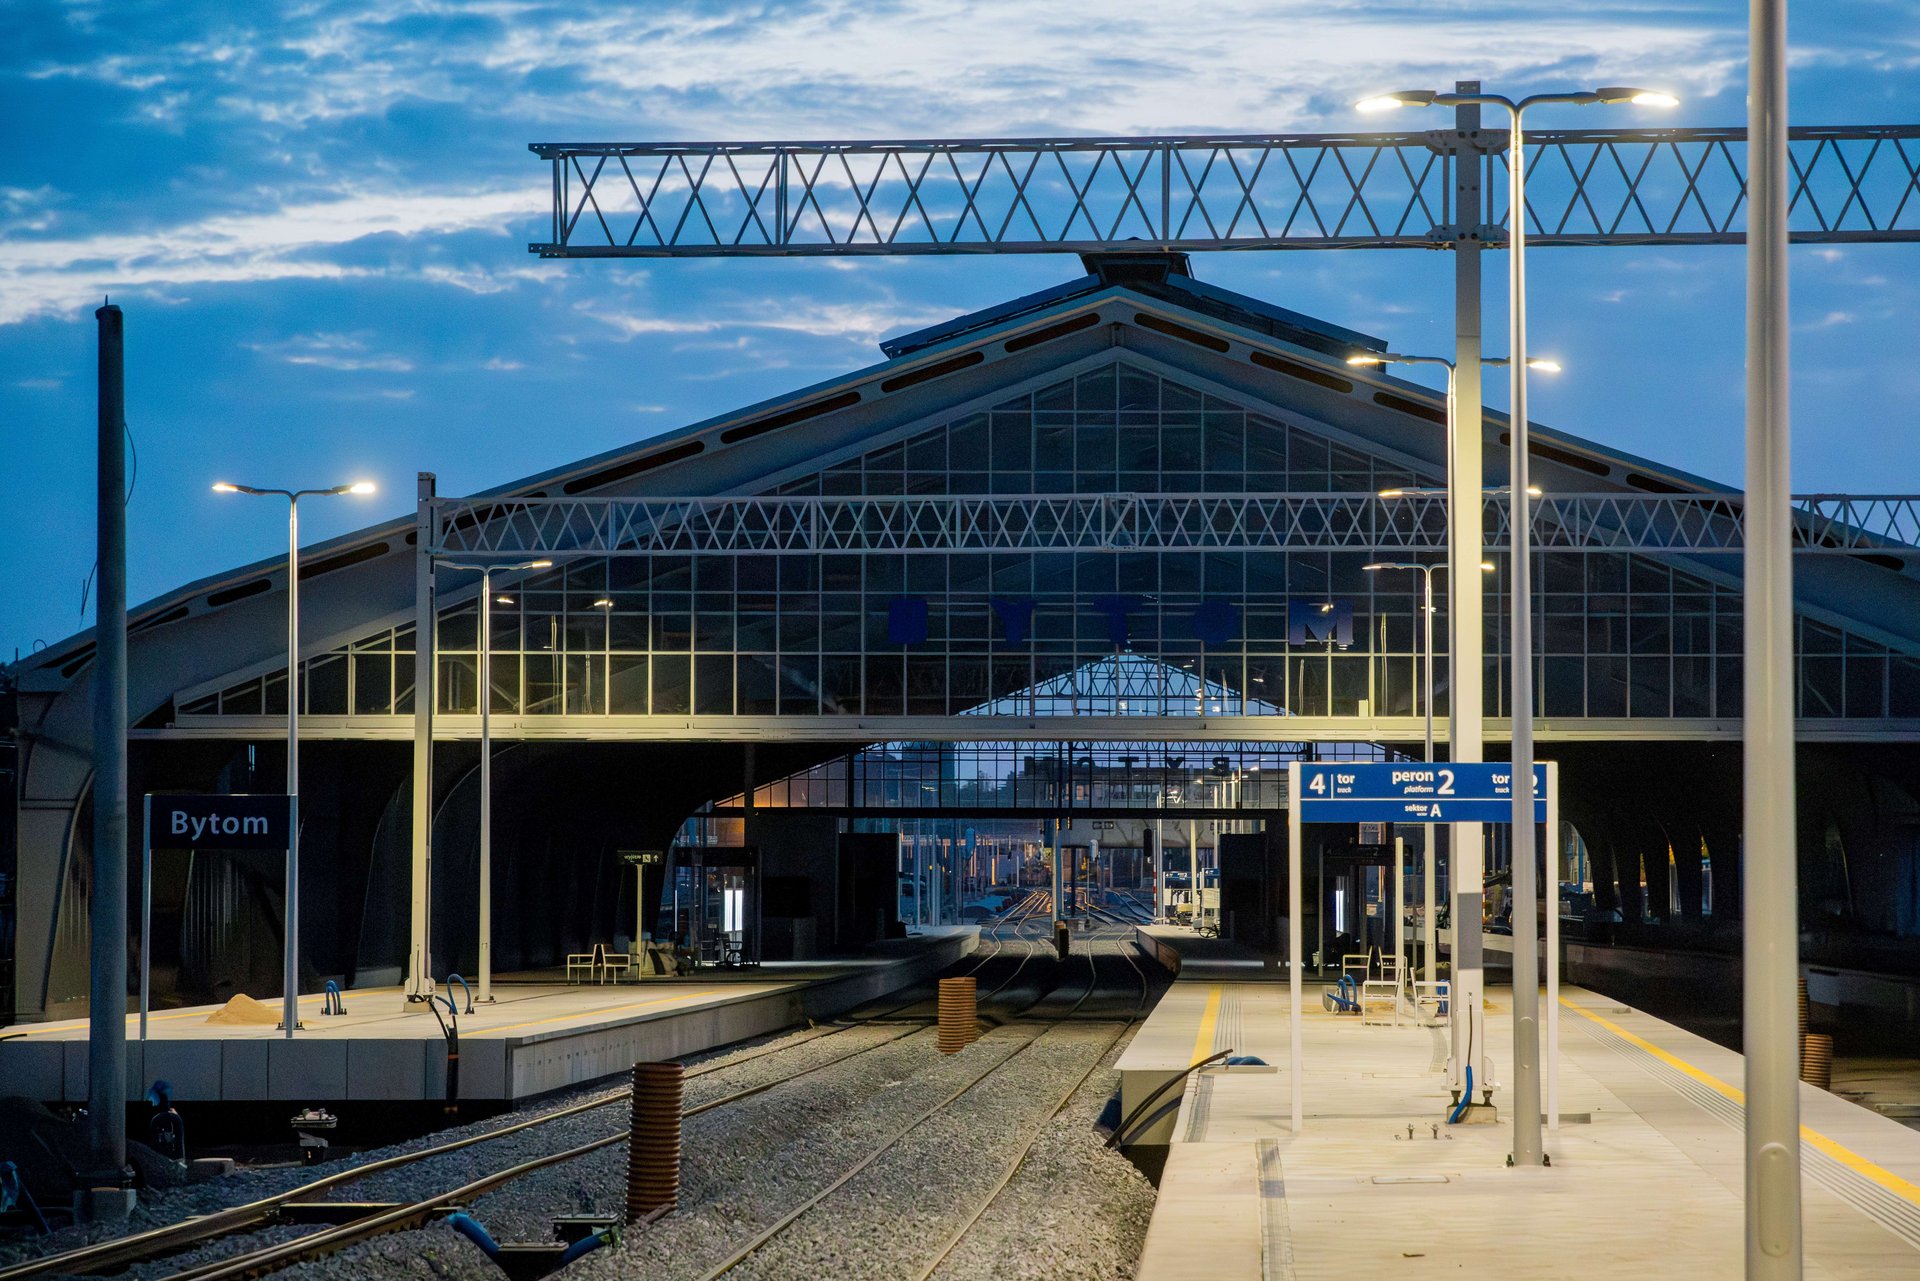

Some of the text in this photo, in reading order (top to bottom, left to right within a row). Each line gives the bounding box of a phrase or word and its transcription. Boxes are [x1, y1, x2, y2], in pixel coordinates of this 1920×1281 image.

[1309, 773, 1326, 795] 4
[1337, 773, 1355, 784] tor
[1391, 769, 1455, 795] peron 2
[1491, 773, 1510, 784] tor
[1403, 785, 1434, 795] platform
[1404, 803, 1428, 812] sektor
[1430, 803, 1442, 818] A
[171, 810, 268, 841] Bytom
